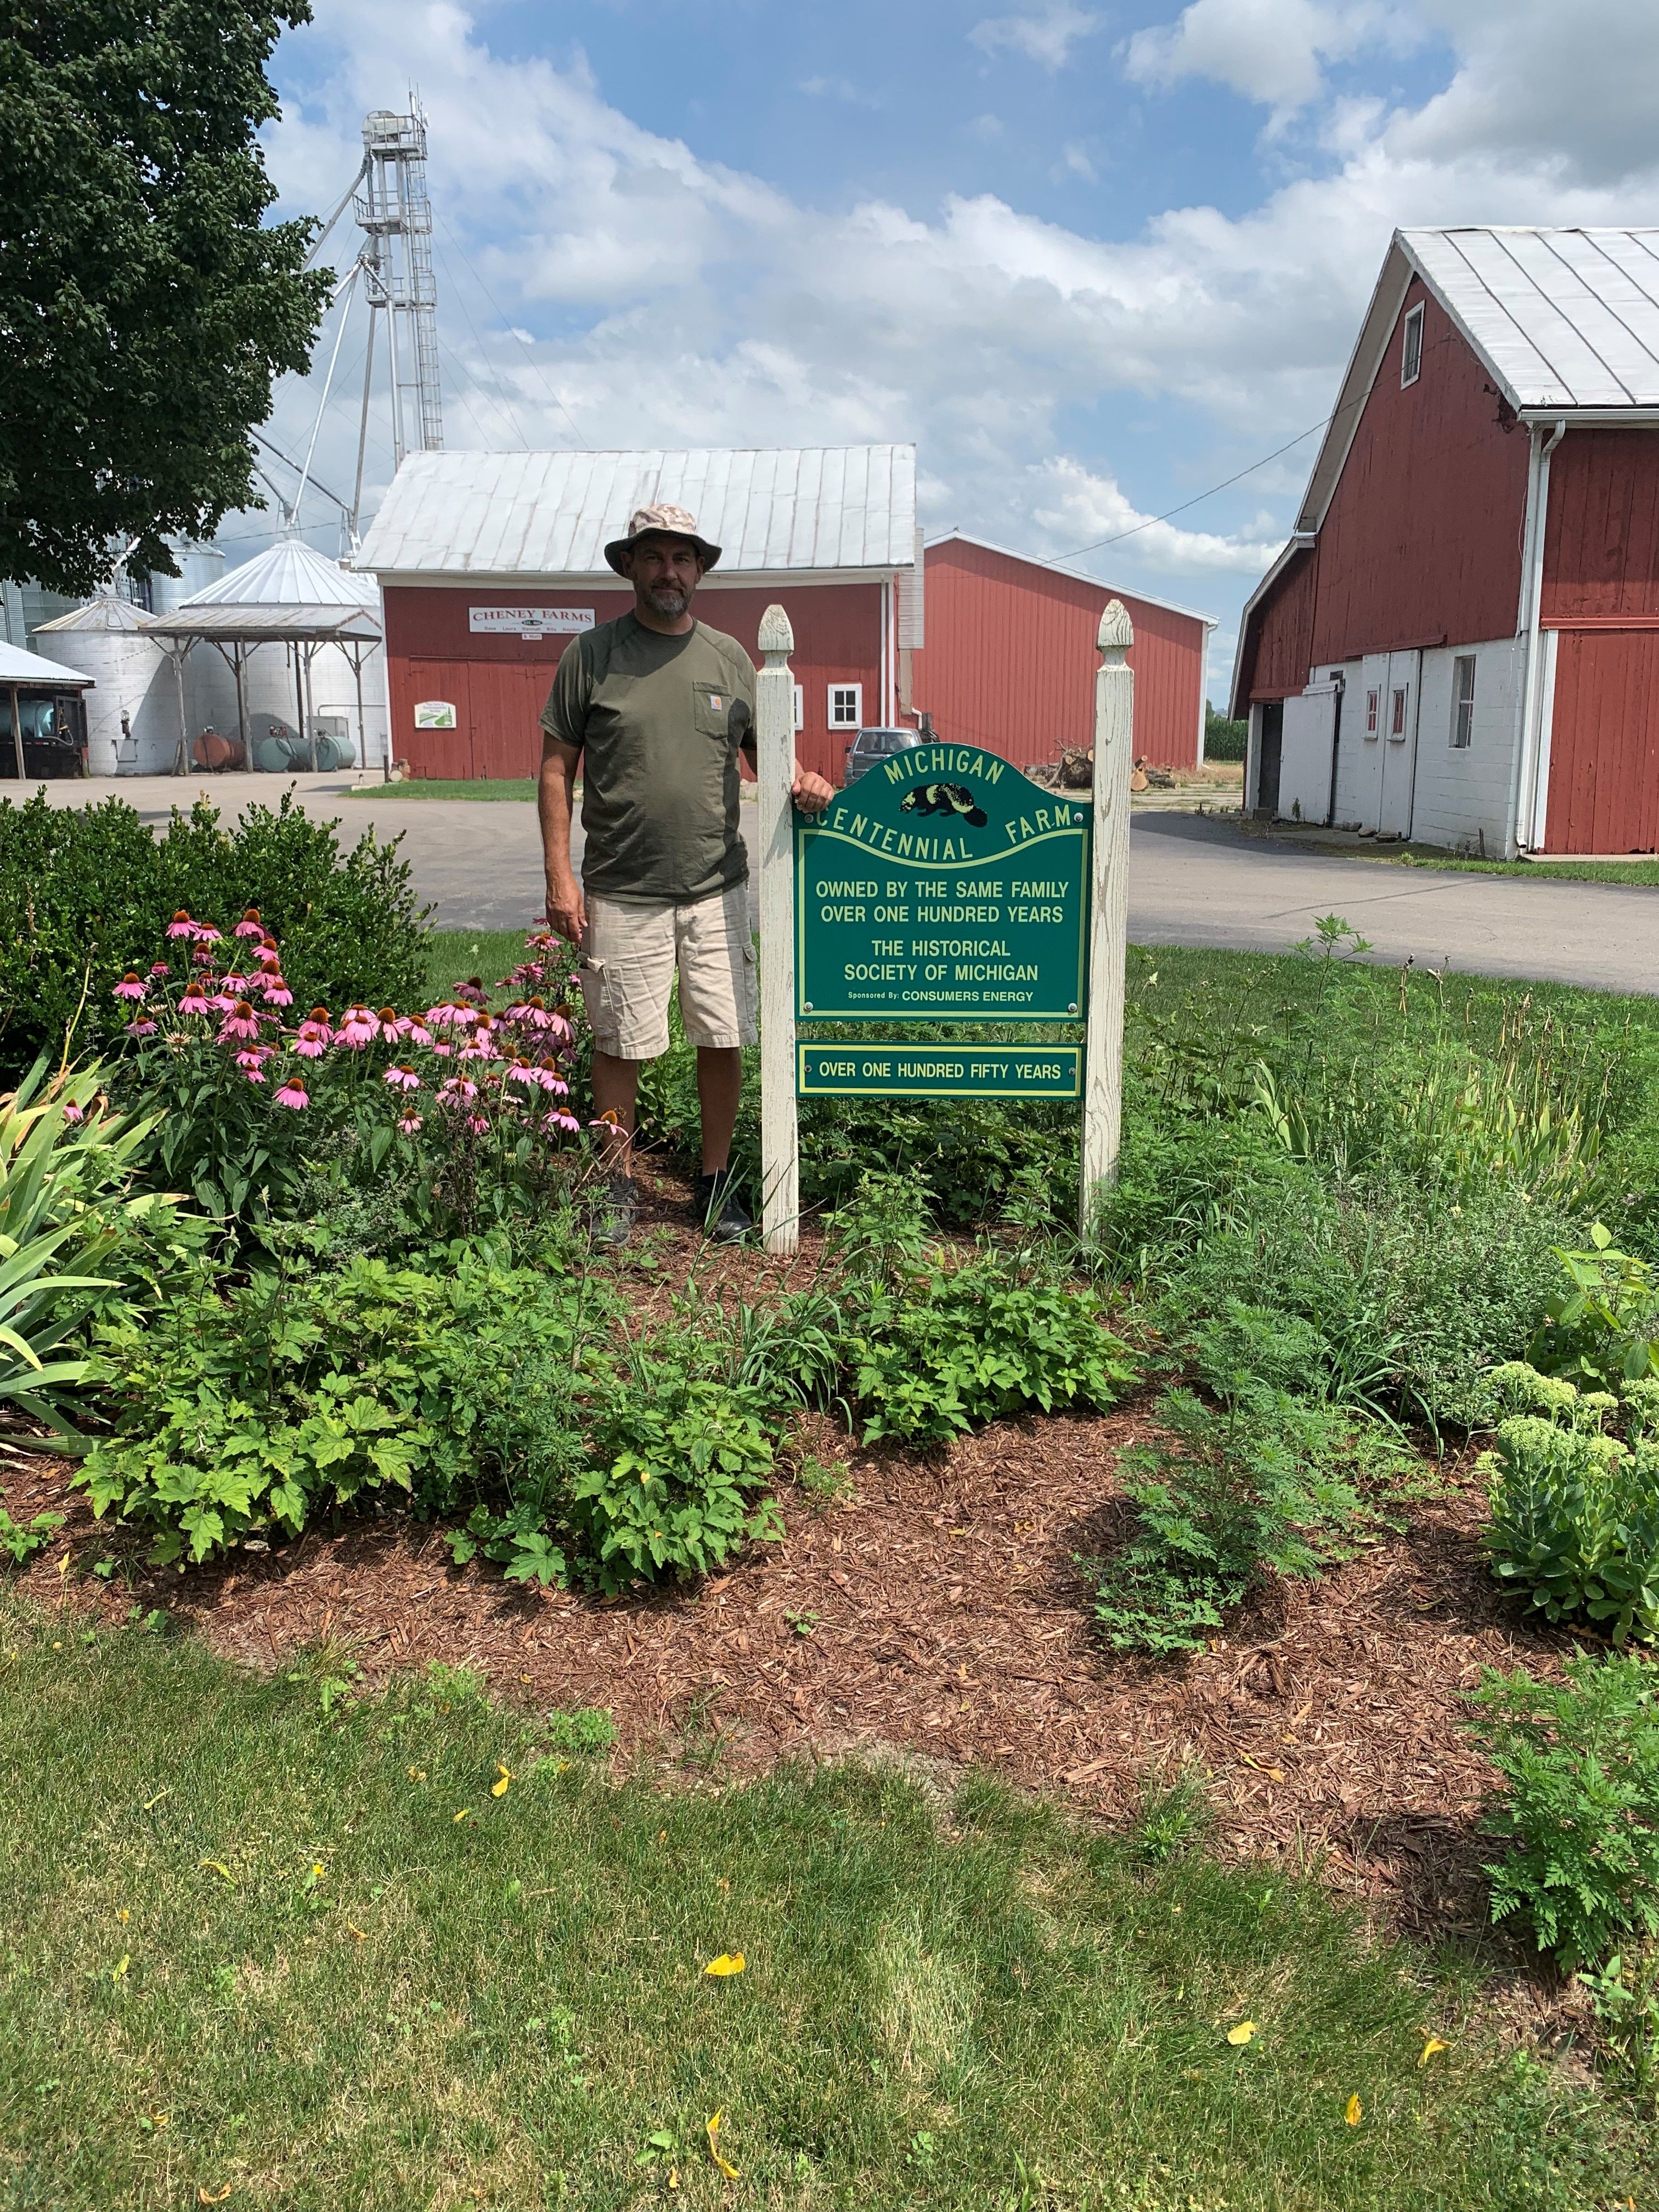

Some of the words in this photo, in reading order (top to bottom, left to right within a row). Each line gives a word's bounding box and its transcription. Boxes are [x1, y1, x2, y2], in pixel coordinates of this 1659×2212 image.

[473, 610, 535, 622] CHENEY
[543, 611, 592, 623] FARMS
[884, 748, 1005, 786] MICHIGAN
[816, 807, 973, 860] CENTENNIAL
[1005, 804, 1071, 844] FARM
[816, 881, 878, 897] OWNED
[887, 882, 907, 897] BY
[915, 882, 946, 897] THE
[956, 882, 1002, 898] SAME
[1012, 882, 1069, 897] FAMILY
[821, 906, 865, 922] OVER
[874, 906, 909, 922] ONE
[918, 906, 999, 922] HUNDRED
[1008, 906, 1063, 922] YEARS
[872, 940, 903, 956] THE
[913, 940, 1010, 956] HISTORICAL
[845, 964, 917, 980] SOCIETY
[925, 964, 947, 980] OF
[956, 965, 1037, 980] MICHIGAN
[902, 991, 979, 1001] CONSUMERS
[983, 992, 1032, 1001] ENERGY
[820, 1062, 855, 1076] OVER
[863, 1063, 890, 1076] ONE
[899, 1063, 963, 1077] HUNDRED
[971, 1064, 1008, 1078] FIFTY
[1015, 1064, 1060, 1079] YEARS
